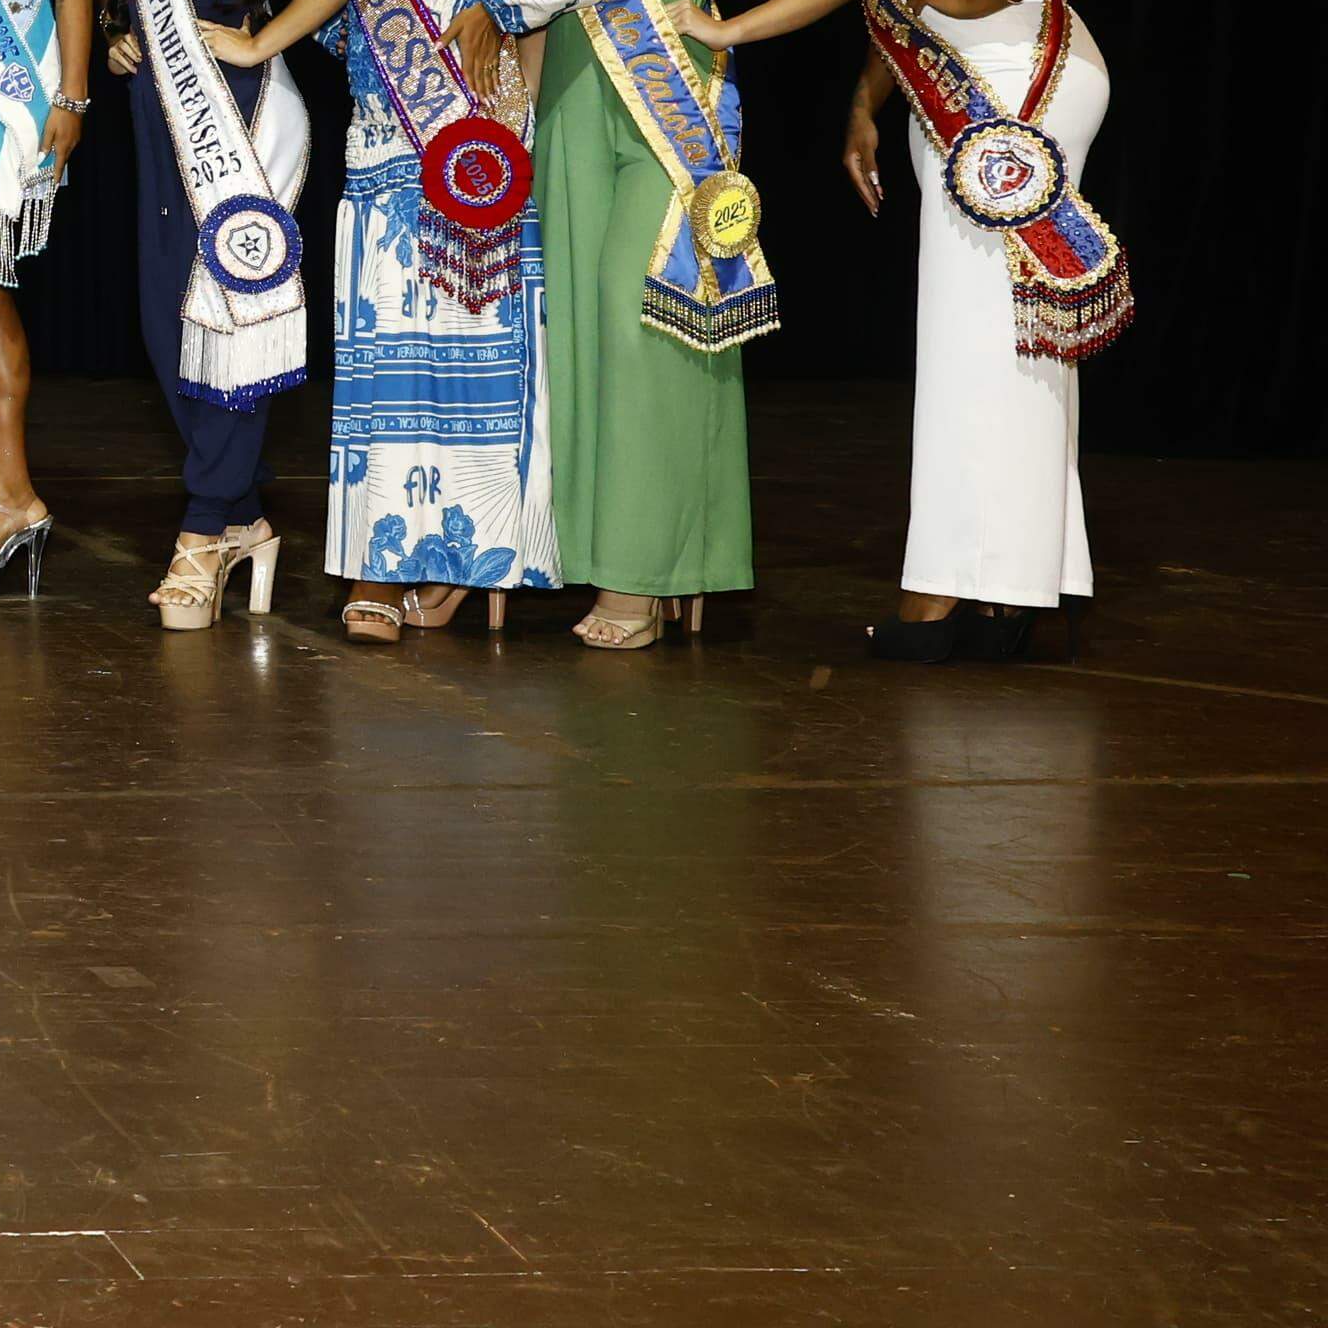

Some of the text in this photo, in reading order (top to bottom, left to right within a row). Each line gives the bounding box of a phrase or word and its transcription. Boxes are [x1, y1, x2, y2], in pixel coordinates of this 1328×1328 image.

[374, 7, 456, 132] CSSA
[606, 7, 711, 164] do Casota
[190, 150, 243, 188] 2025
[460, 153, 493, 196] 2025
[714, 199, 746, 228] 2025
